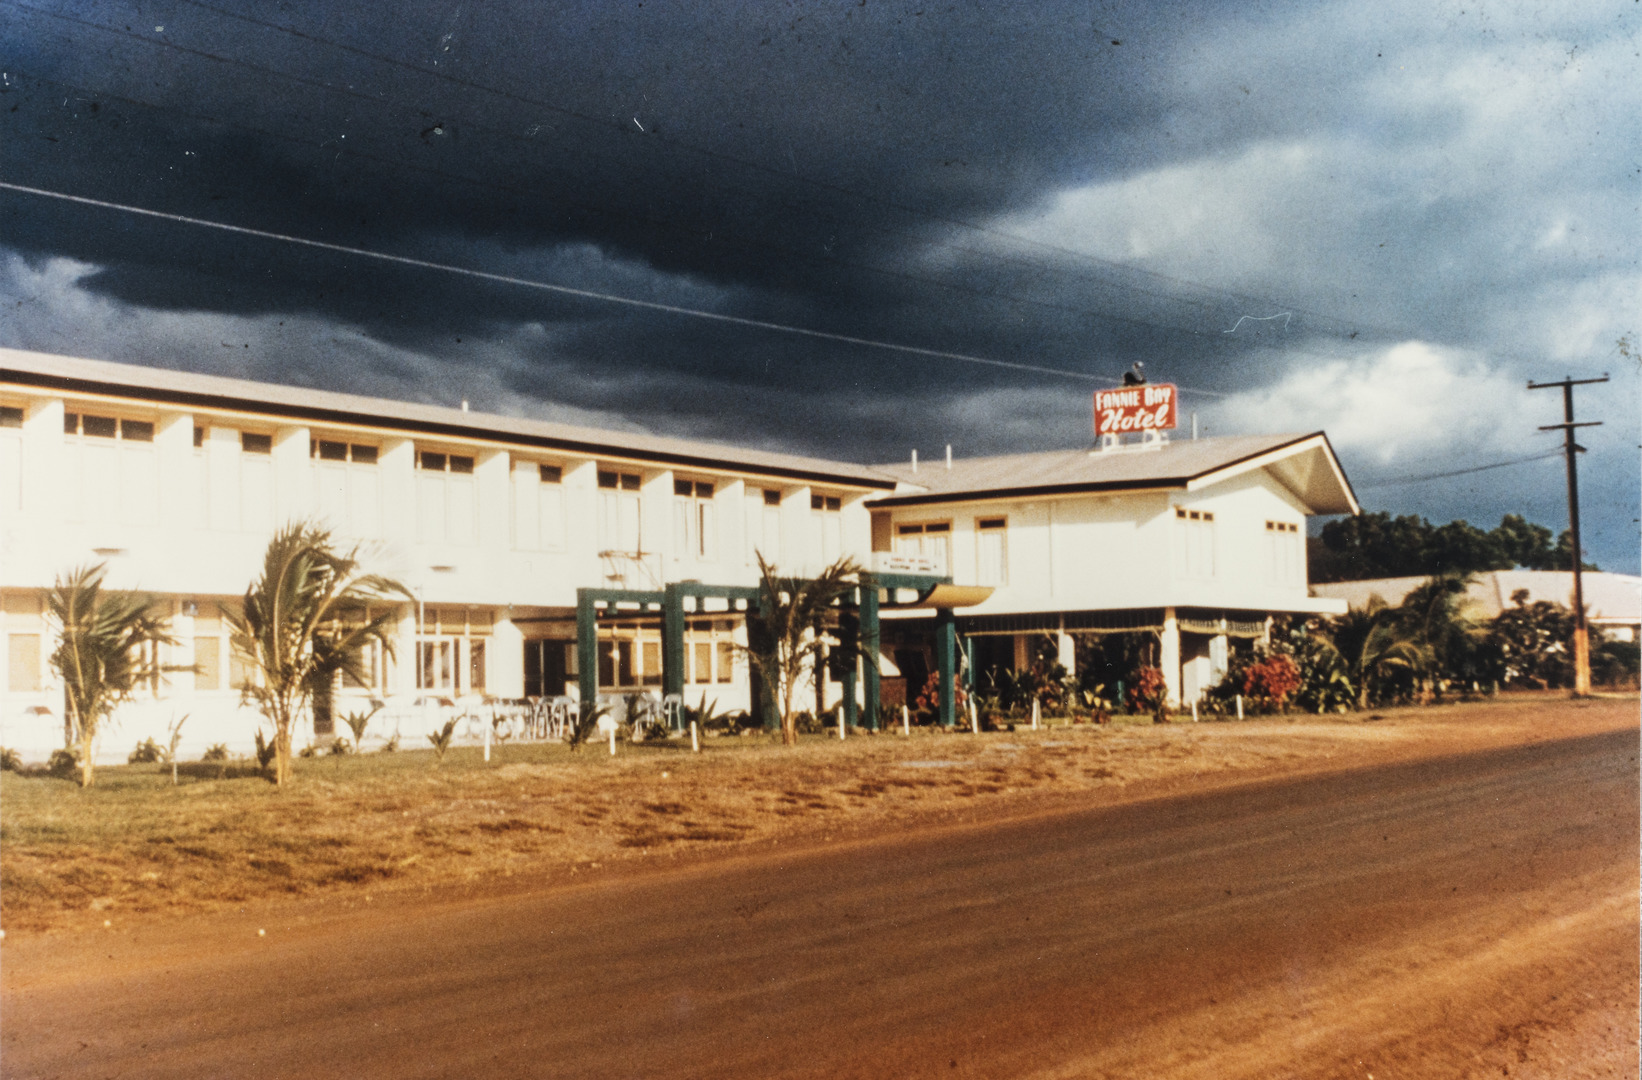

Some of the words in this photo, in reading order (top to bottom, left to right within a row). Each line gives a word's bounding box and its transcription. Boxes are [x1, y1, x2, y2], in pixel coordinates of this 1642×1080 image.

[1096, 391, 1140, 411] FANNIE
[1144, 387, 1171, 406] BAY
[1100, 403, 1169, 432] Hotel
